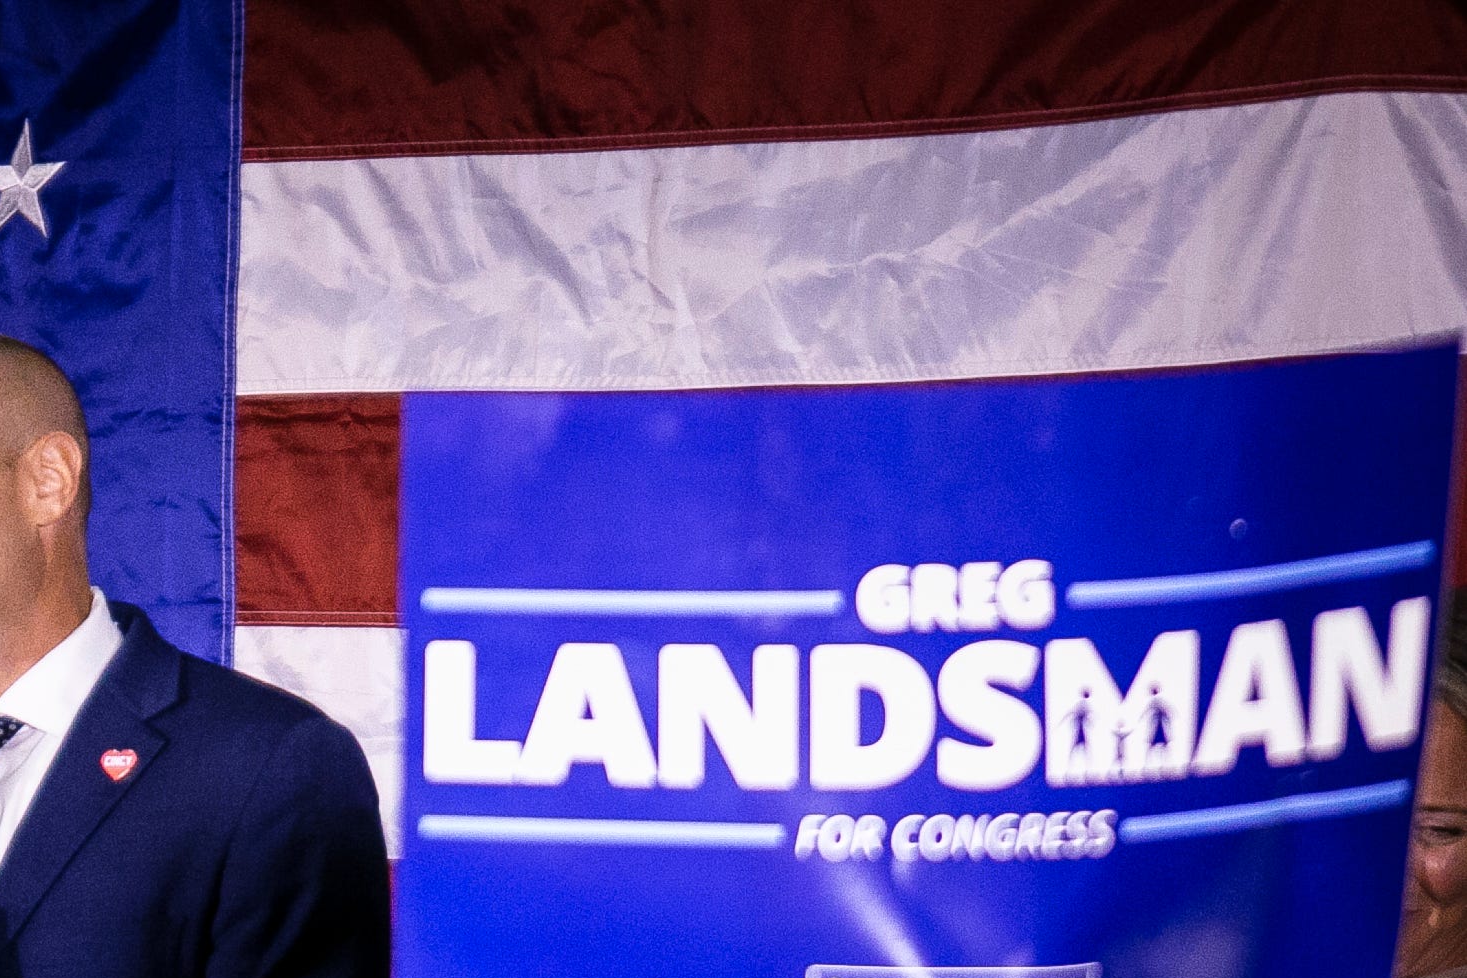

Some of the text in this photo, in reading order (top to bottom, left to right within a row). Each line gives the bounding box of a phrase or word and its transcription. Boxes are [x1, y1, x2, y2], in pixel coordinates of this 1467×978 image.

[855, 559, 1055, 634] GREG
[422, 597, 1431, 790] LANDSMAN
[794, 808, 1118, 863] FOR CONGRESS
